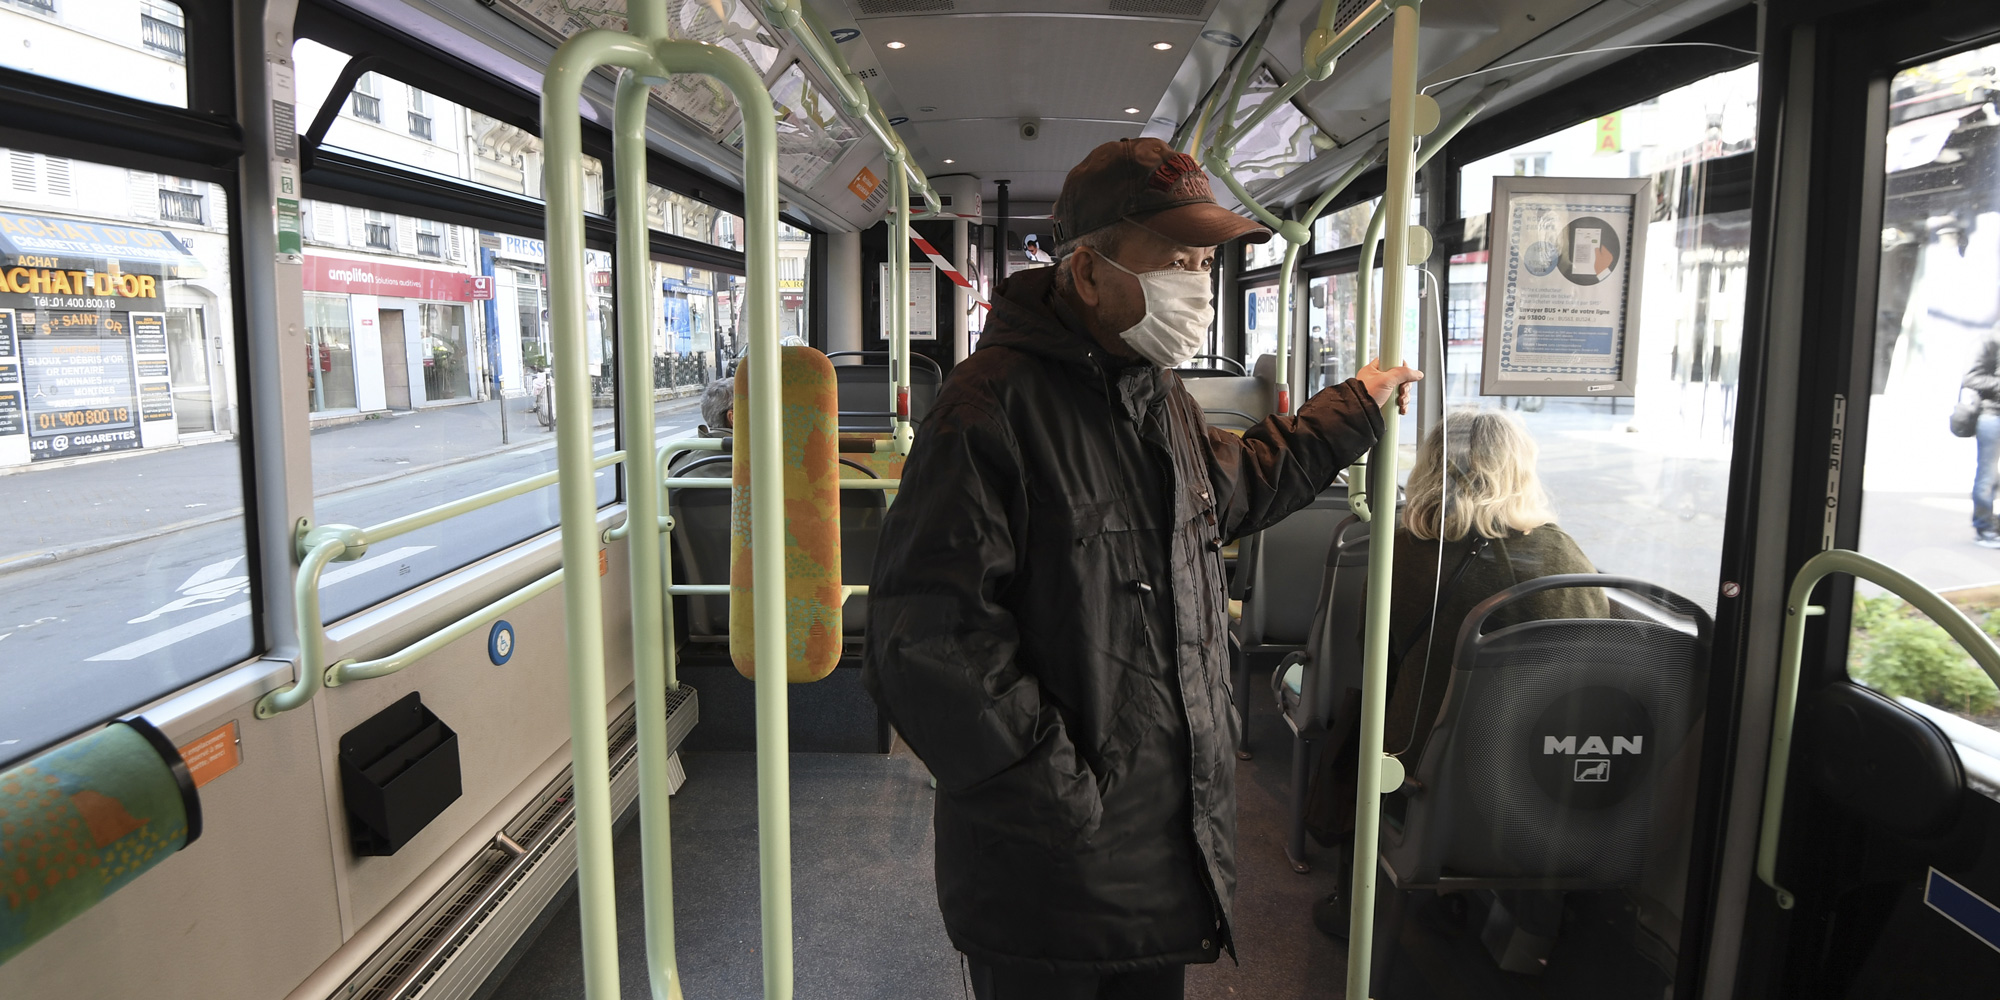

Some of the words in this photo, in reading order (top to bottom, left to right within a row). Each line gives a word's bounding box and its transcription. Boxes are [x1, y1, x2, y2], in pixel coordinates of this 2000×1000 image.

[0, 216, 100, 242] ACHAT
[103, 226, 172, 250] D'OR
[182, 238, 193, 248] 70
[11, 235, 93, 253] CIGARETTE
[95, 242, 179, 259] ELECTRONI
[18, 255, 58, 268] ACHAT
[328, 268, 374, 285] amplifon
[375, 276, 398, 286] Solutions
[398, 279, 422, 288] auditives
[62, 313, 100, 328] SAINT
[104, 318, 123, 335] OR
[28, 356, 61, 366] BIJOUX
[70, 354, 102, 365] DÉBRIS
[104, 354, 124, 364] d'OR
[46, 367, 60, 377] OR
[62, 366, 105, 376] DENTAIRE
[56, 376, 102, 387] MONNAIES
[74, 386, 116, 397] MONTRES
[39, 413, 56, 429] 01
[59, 411, 84, 427] 400
[85, 409, 110, 425] 800
[113, 408, 128, 422] 18
[32, 439, 48, 451] ICI
[52, 435, 69, 451] @
[73, 430, 136, 446] CIGARETTES
[1829, 398, 1846, 470] TIRER
[1543, 735, 1643, 755] MAN
